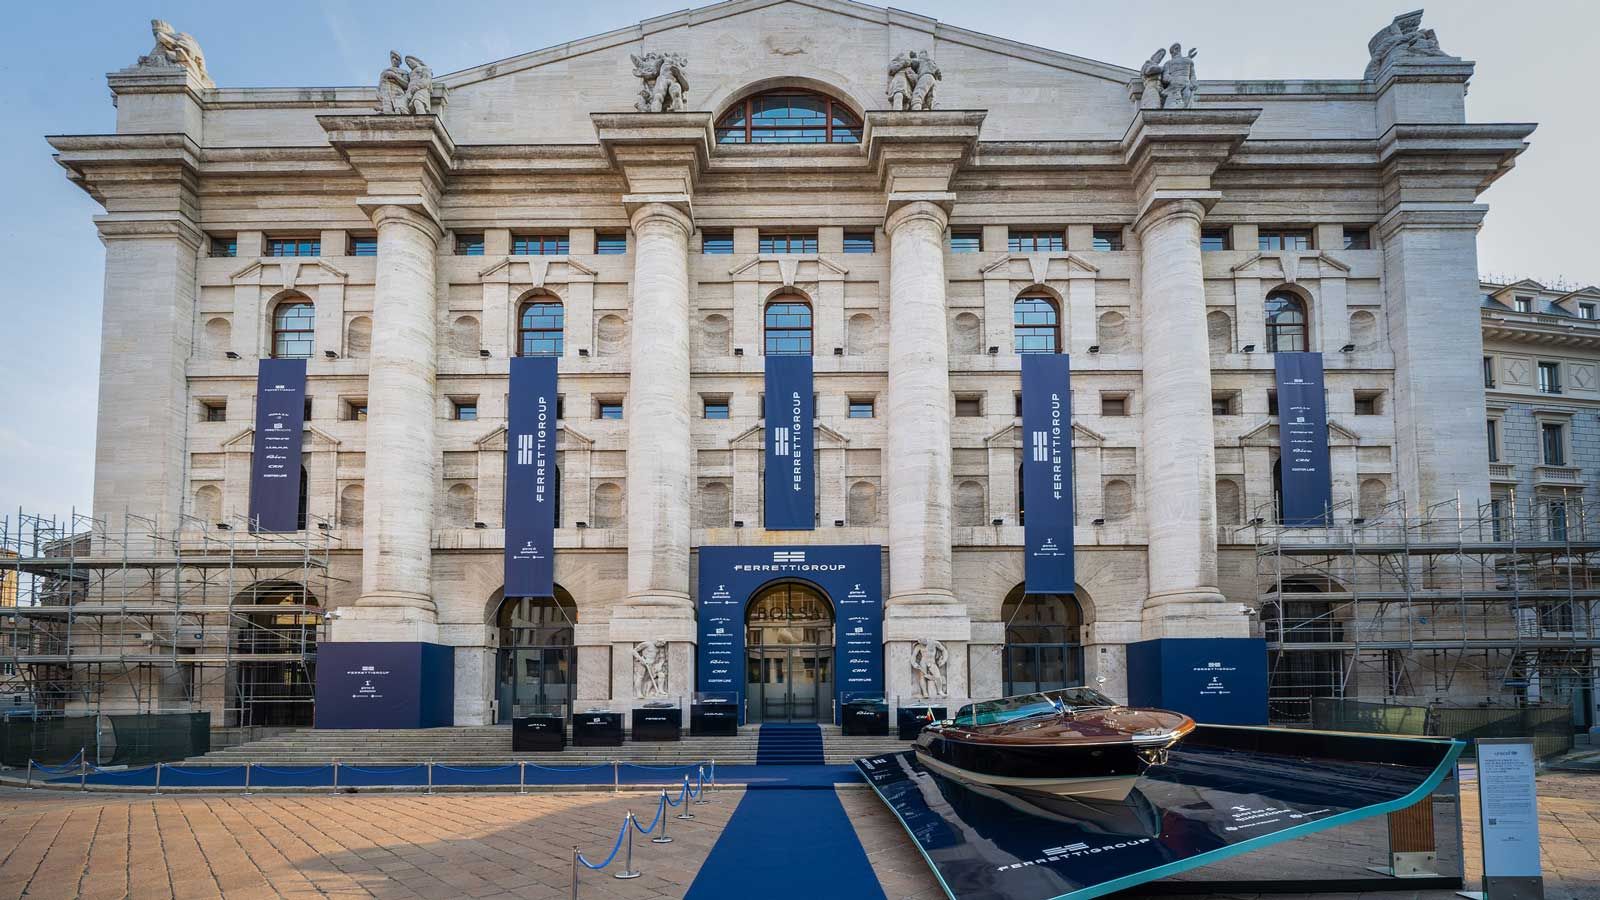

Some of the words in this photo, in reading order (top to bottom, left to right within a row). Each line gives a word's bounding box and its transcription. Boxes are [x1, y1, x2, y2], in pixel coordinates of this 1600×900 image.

[536, 396, 547, 503] FERRETTIGROUP
[792, 391, 802, 492] FERRETTIGROUP
[1051, 393, 1062, 500] FERRETTIGROUP
[996, 838, 1150, 872] FERRETTIGROUP
